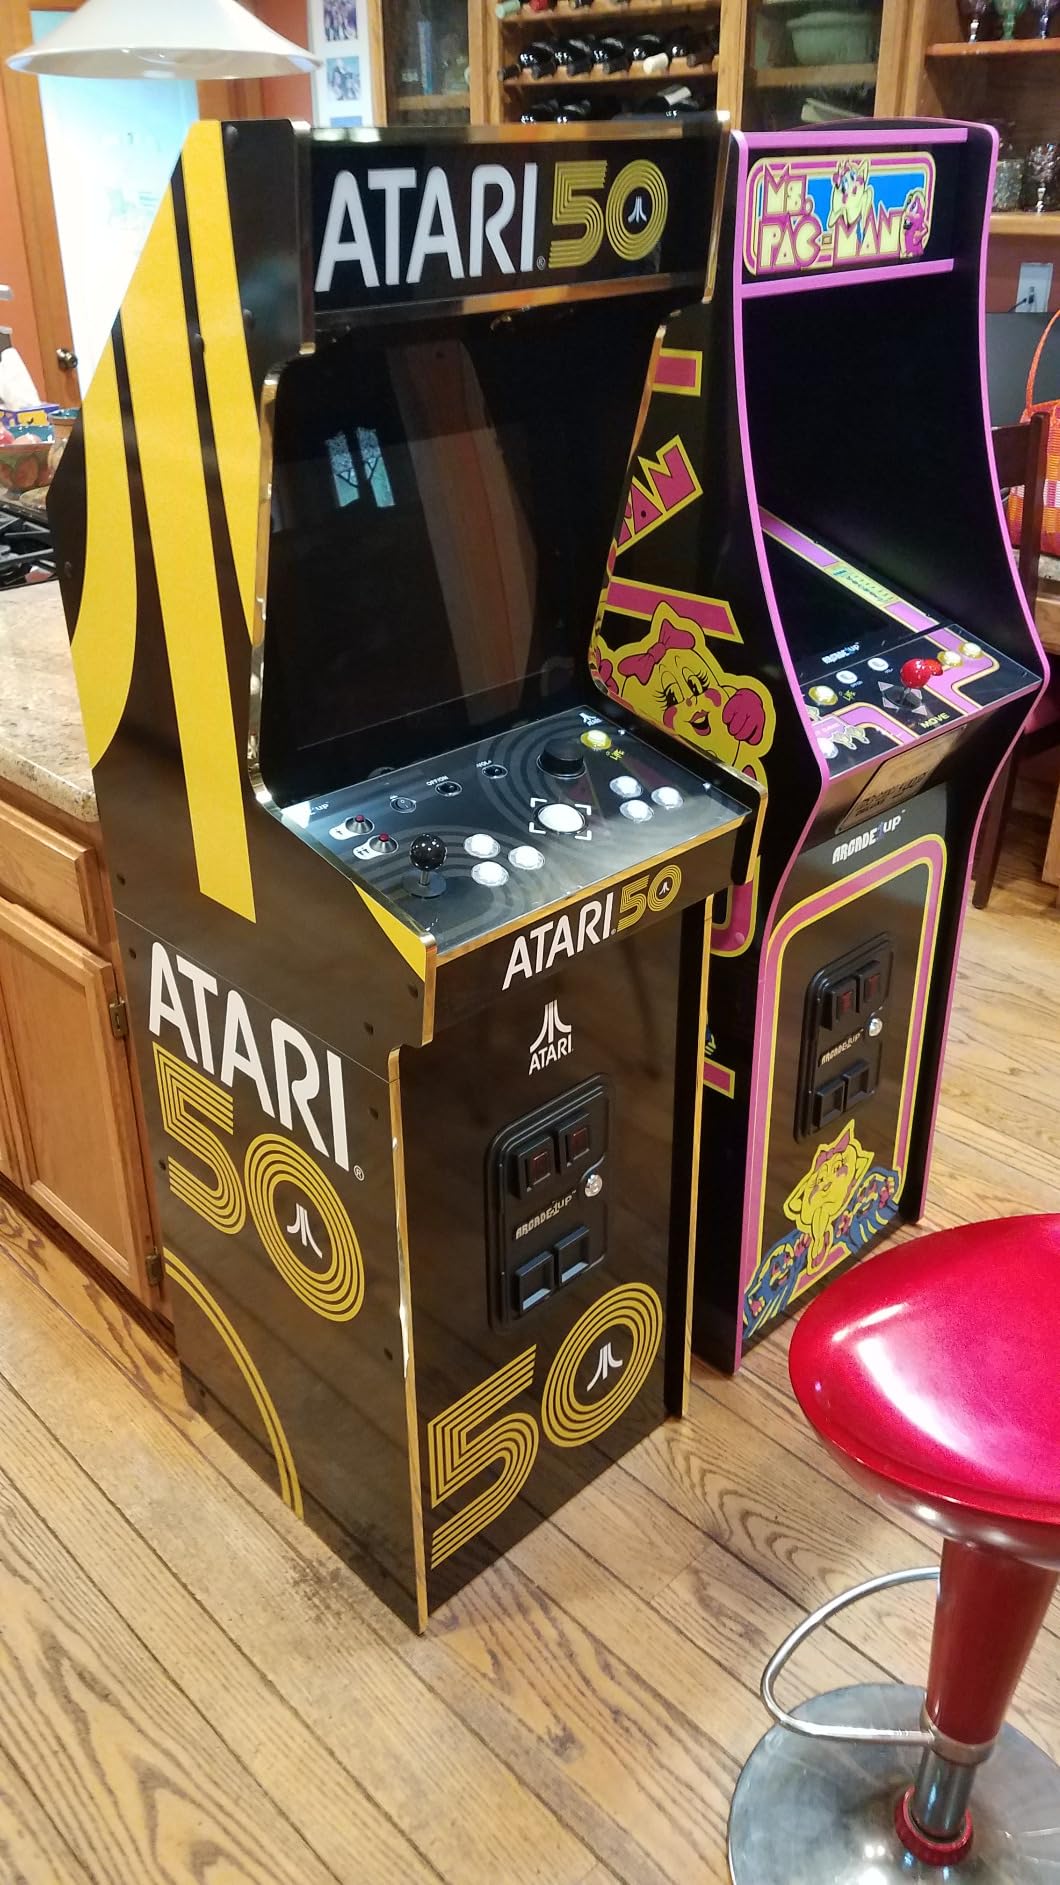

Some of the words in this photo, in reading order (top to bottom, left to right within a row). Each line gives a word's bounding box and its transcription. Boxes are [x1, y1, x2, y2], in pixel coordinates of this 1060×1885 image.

[314, 162, 538, 292] ATARI
[548, 158, 668, 268] 50
[920, 711, 950, 729] MOVE
[501, 891, 615, 991] ATARI
[616, 864, 682, 933] 50
[148, 941, 350, 1173] ATARI
[528, 1033, 573, 1076] ATARI
[152, 1040, 366, 1323] 50
[427, 1281, 664, 1571] 50
